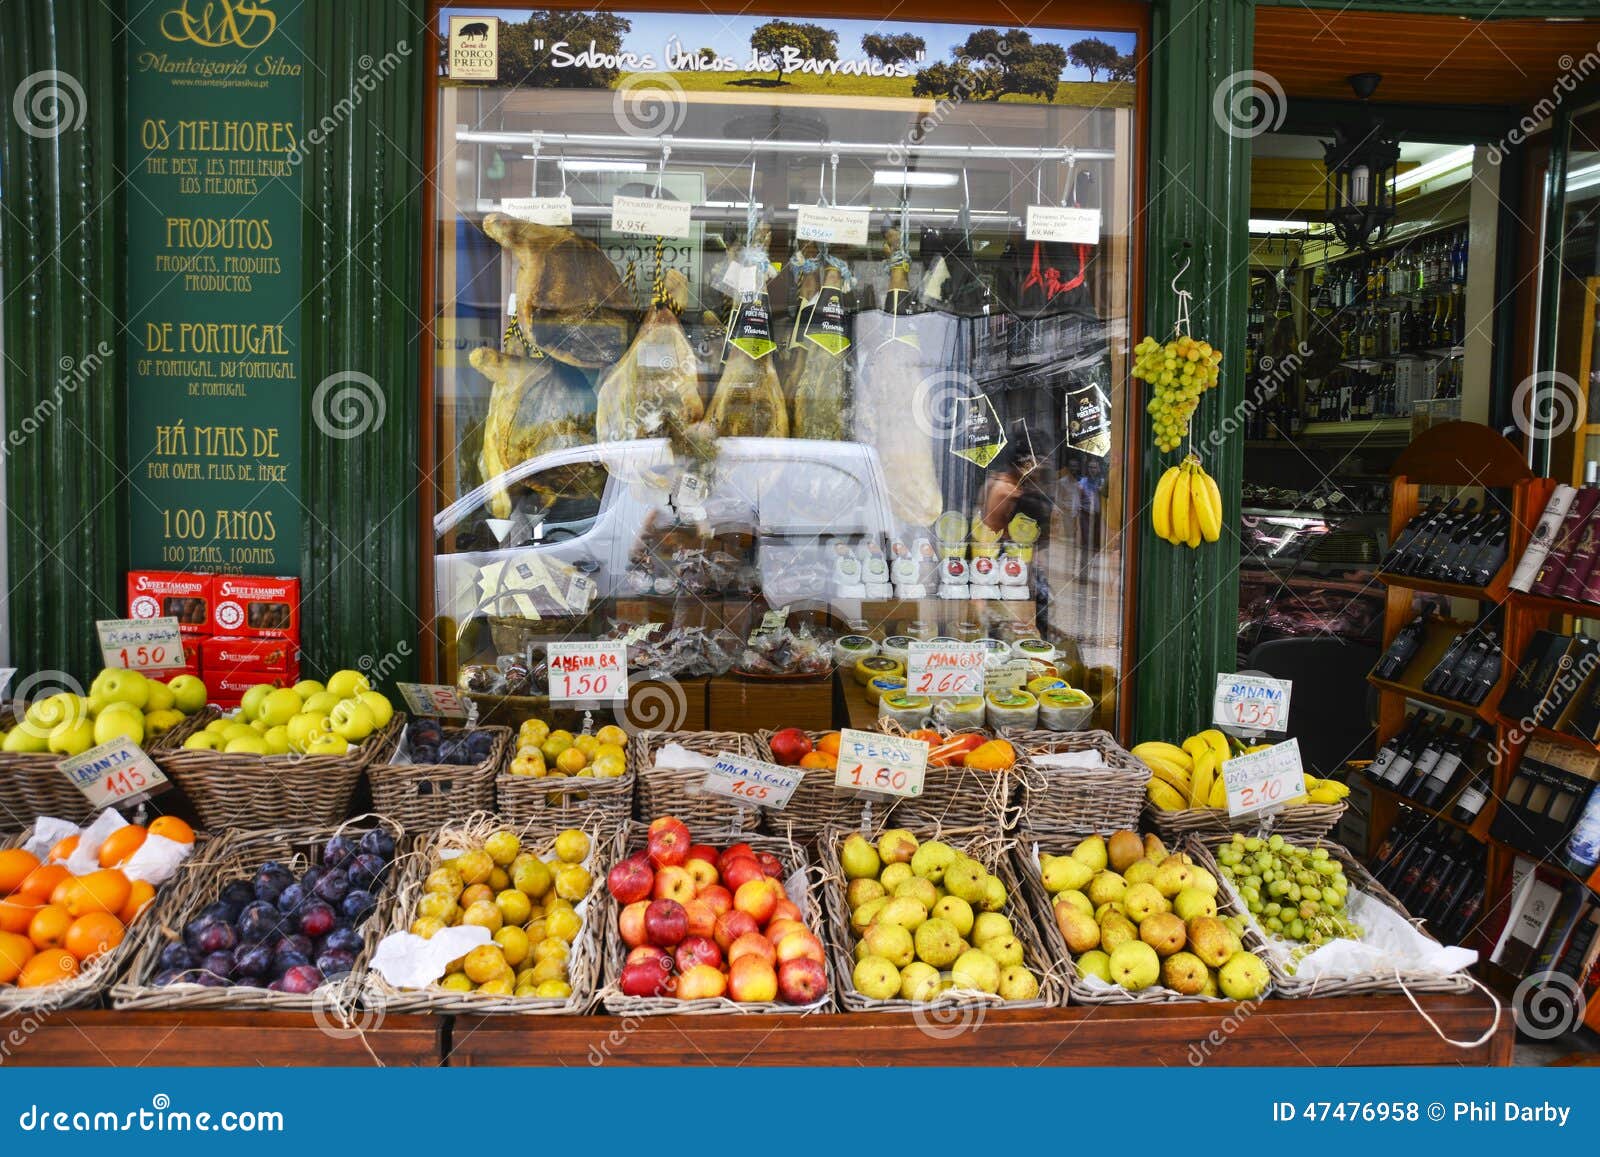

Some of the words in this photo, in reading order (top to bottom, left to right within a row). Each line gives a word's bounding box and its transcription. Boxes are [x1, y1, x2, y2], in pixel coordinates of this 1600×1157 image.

[454, 50, 493, 58] PORCO
[665, 33, 738, 72] Únicos
[745, 48, 773, 72] de
[137, 52, 248, 78] Manteigaria
[256, 55, 301, 77] Silva
[454, 59, 493, 67] PRETO
[171, 78, 269, 89] www.manteigariasilva.pt
[143, 120, 170, 151] OS
[179, 121, 297, 153] MELHORES
[146, 158, 168, 175] THE
[207, 159, 225, 176] LES
[229, 159, 292, 177] MEILLEURS
[181, 178, 200, 194] LOS
[204, 178, 258, 195] MEJORES
[166, 218, 273, 250] PRODUTOS
[224, 256, 281, 274] PRODUITS
[185, 275, 252, 292] PRODUCTOS
[147, 322, 174, 352] DE
[180, 323, 288, 355] PORTUGAL
[138, 360, 152, 376] OF
[221, 361, 235, 378] DU
[239, 361, 296, 379] PORTUGAL
[202, 383, 247, 397] PORTUGAL
[156, 418, 188, 456] HÁ
[194, 426, 248, 457] MAIS
[253, 428, 280, 458] DE
[148, 462, 169, 479] FOR
[208, 464, 236, 481] PLUS
[259, 465, 287, 482] HACE
[162, 509, 206, 539] 100
[215, 510, 276, 541] ANOS
[163, 546, 184, 562] 100
[926, 651, 984, 668] MANGAS
[1231, 683, 1282, 700] BANANA
[69, 750, 132, 783] LARANJA
